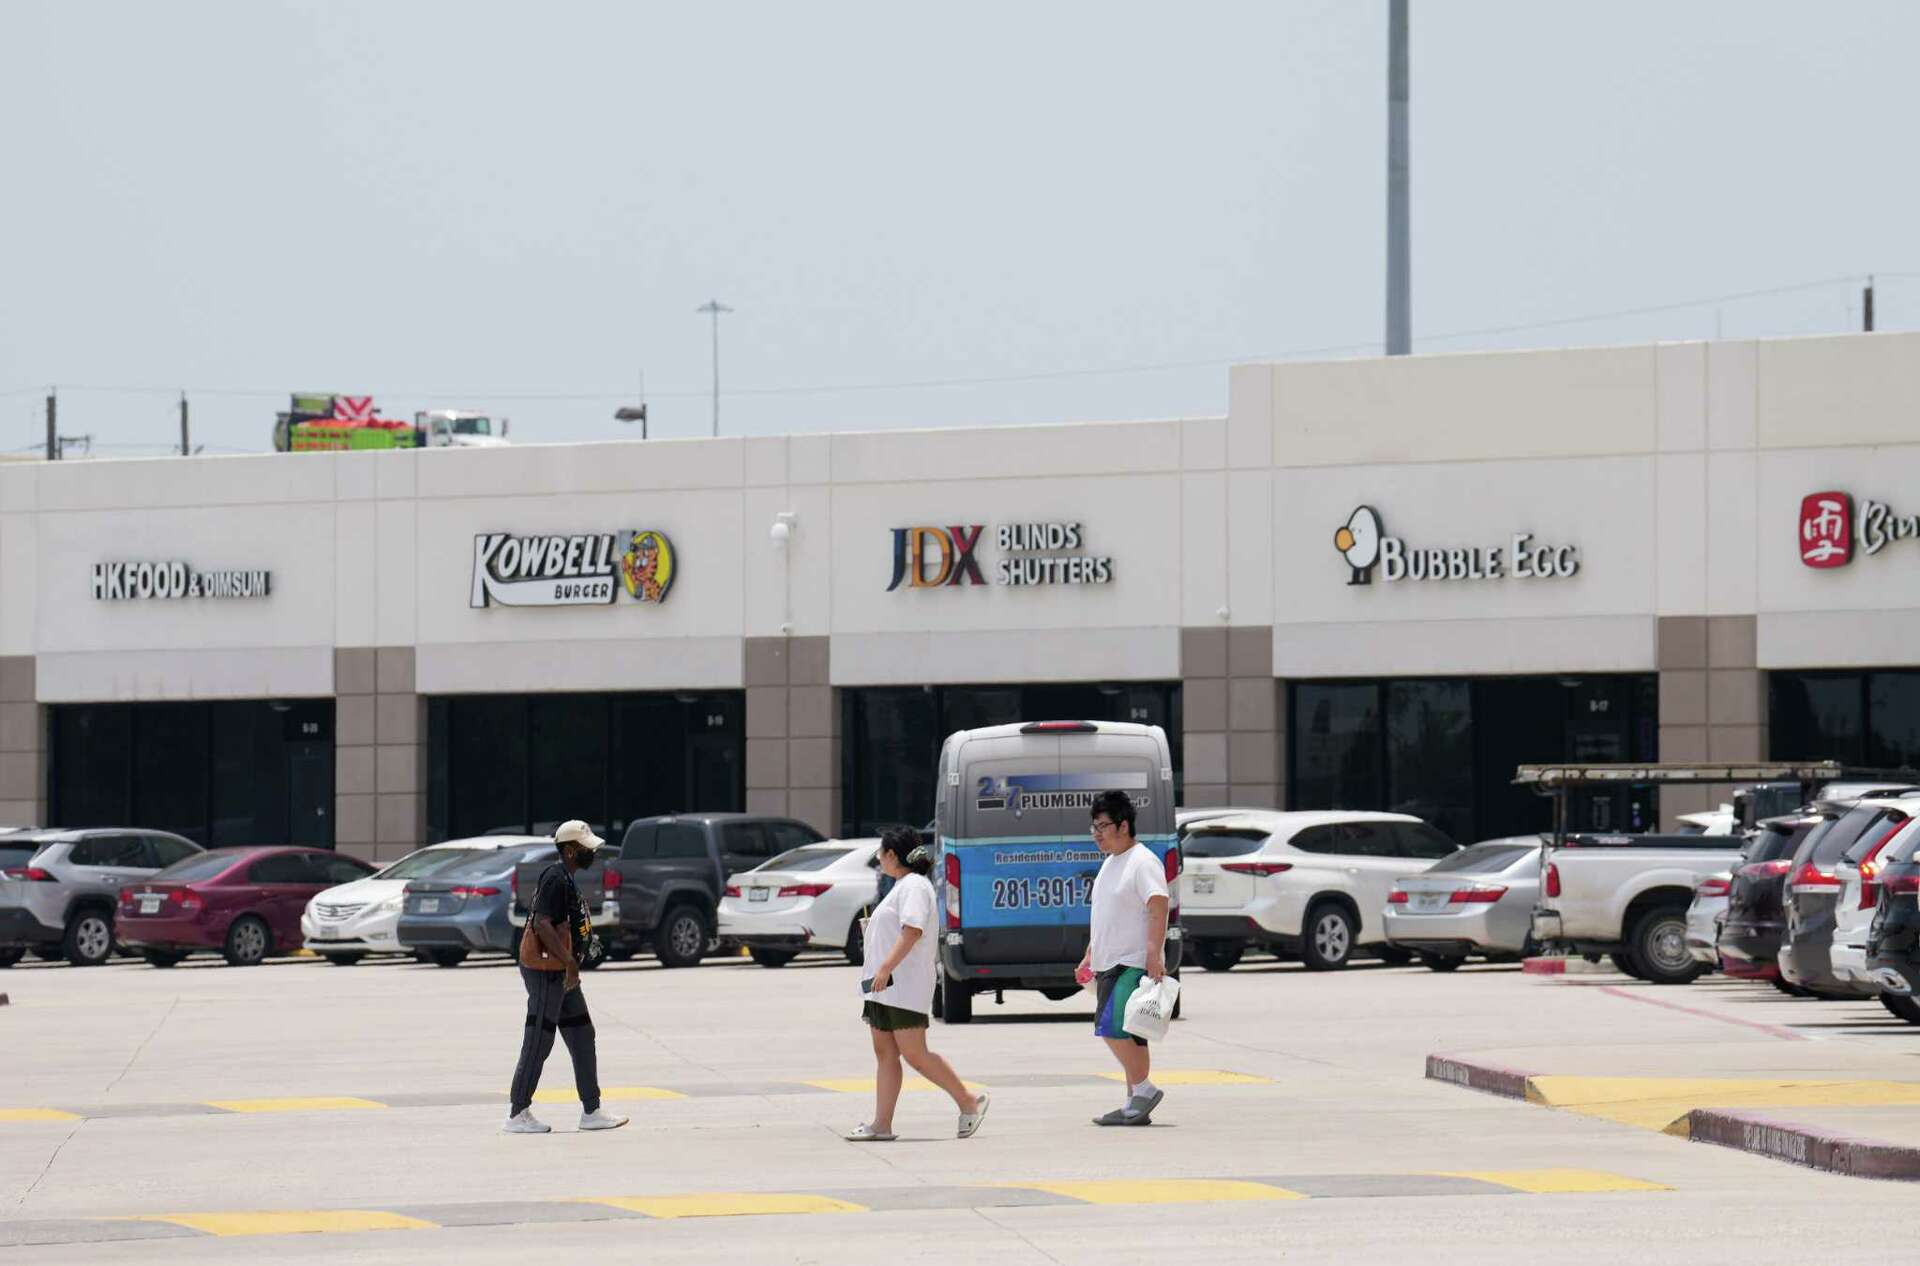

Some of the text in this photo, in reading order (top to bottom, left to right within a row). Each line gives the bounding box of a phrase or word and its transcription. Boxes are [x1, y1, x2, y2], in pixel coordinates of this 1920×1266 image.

[998, 523, 1081, 550] BLINDS
[1858, 500, 1920, 555] Bin
[470, 533, 616, 608] KOWBELL
[886, 524, 988, 592] JDX
[998, 557, 1111, 585] SHUTTERS
[91, 562, 269, 600] HKFOOD & DIMSUM
[555, 583, 609, 599] BURGER
[1021, 791, 1101, 809] PLUMBIN
[995, 850, 1053, 865] Residential
[992, 876, 1095, 909] 281-391-2
